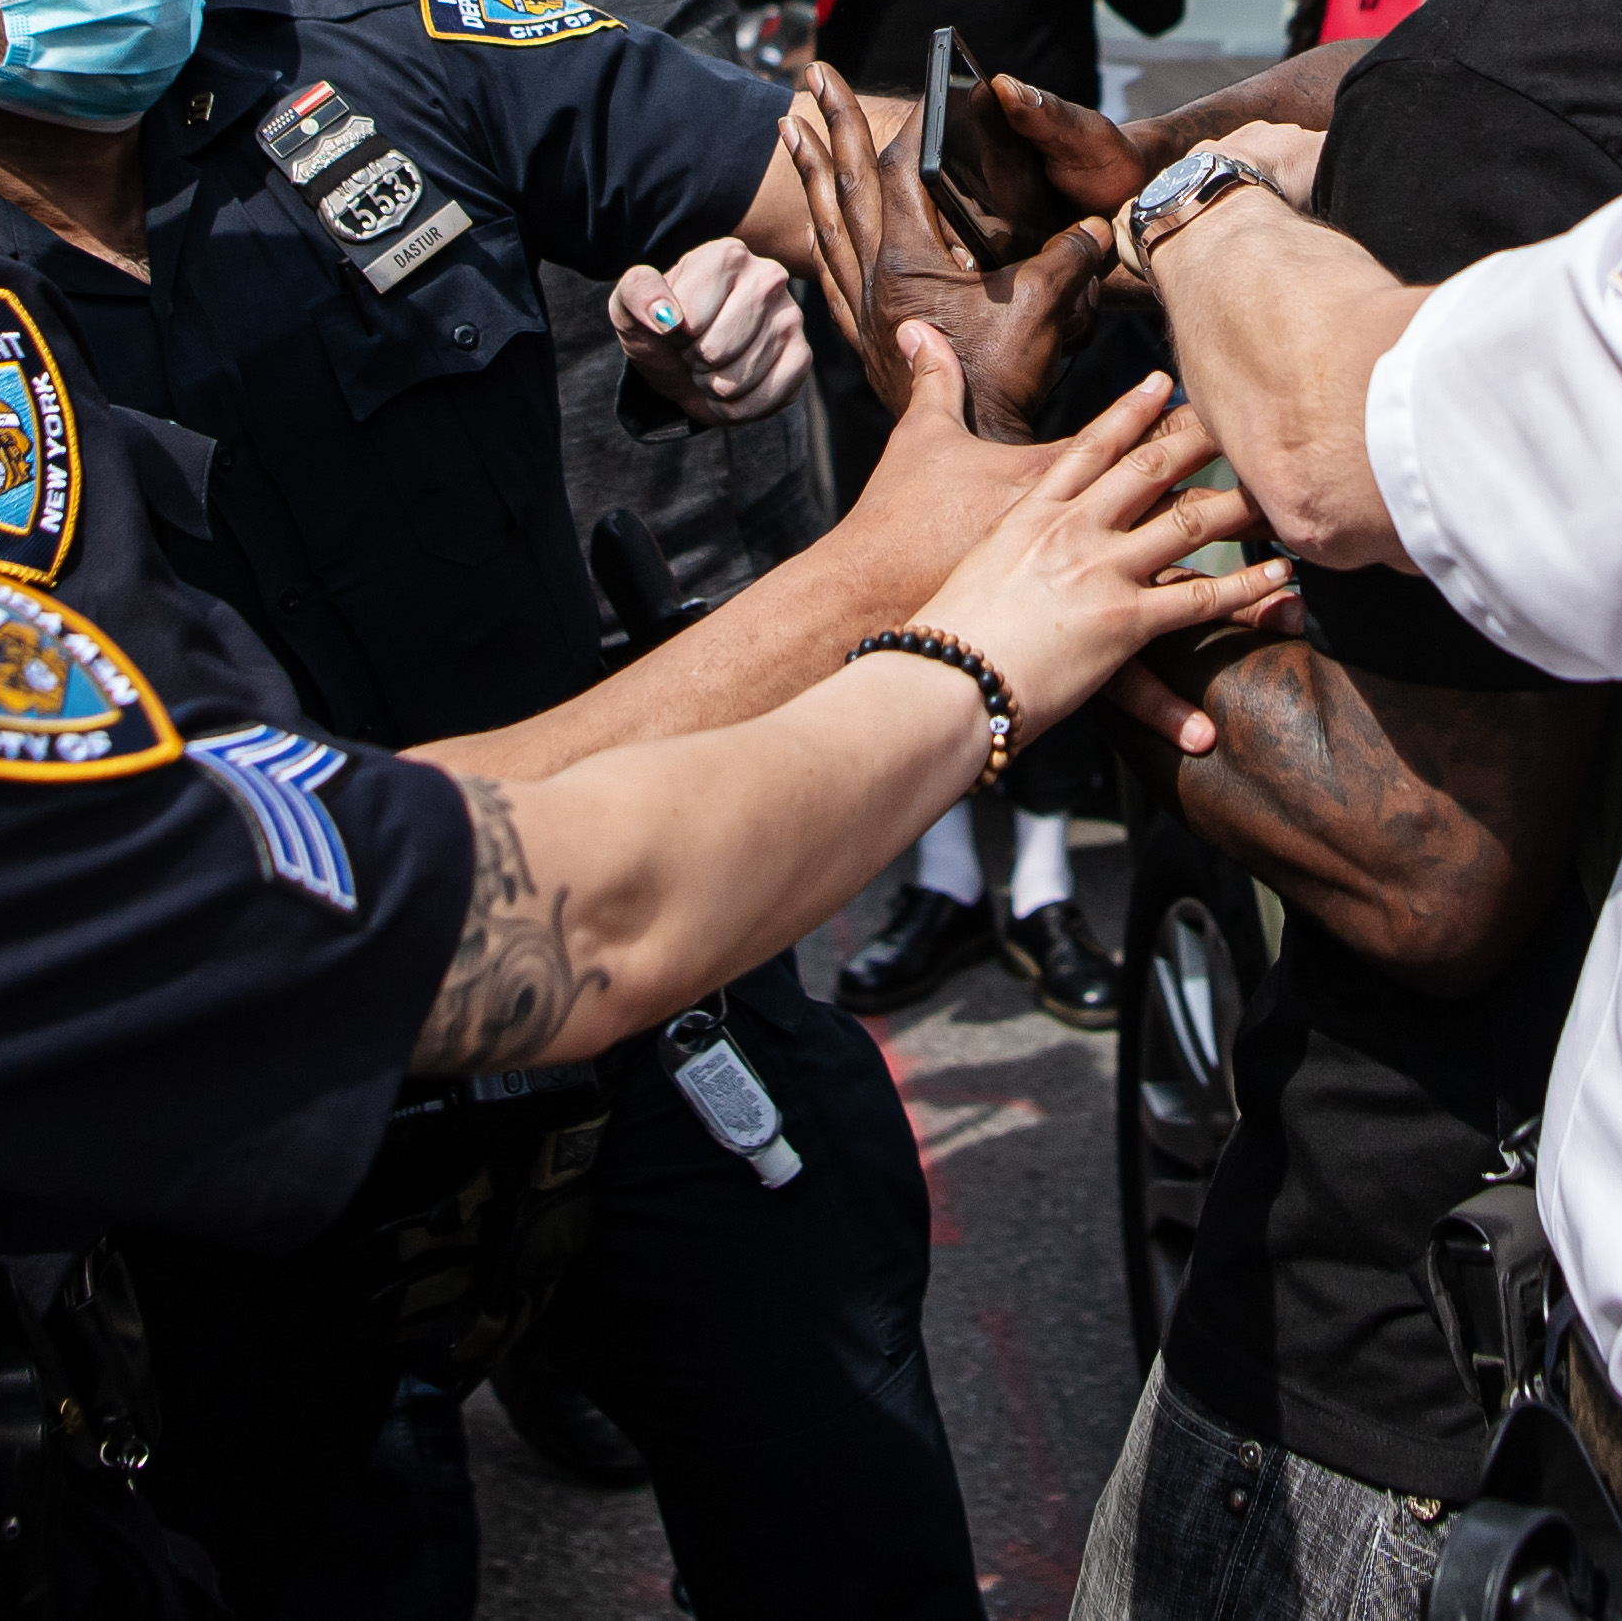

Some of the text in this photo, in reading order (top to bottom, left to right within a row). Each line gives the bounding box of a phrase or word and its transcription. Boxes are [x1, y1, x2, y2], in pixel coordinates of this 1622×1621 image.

[509, 11, 593, 39] CITY OF
[346, 171, 414, 231] 553
[393, 226, 444, 269] DASTUR
[32, 371, 69, 533] NEW YORK
[55, 730, 113, 762] OF
